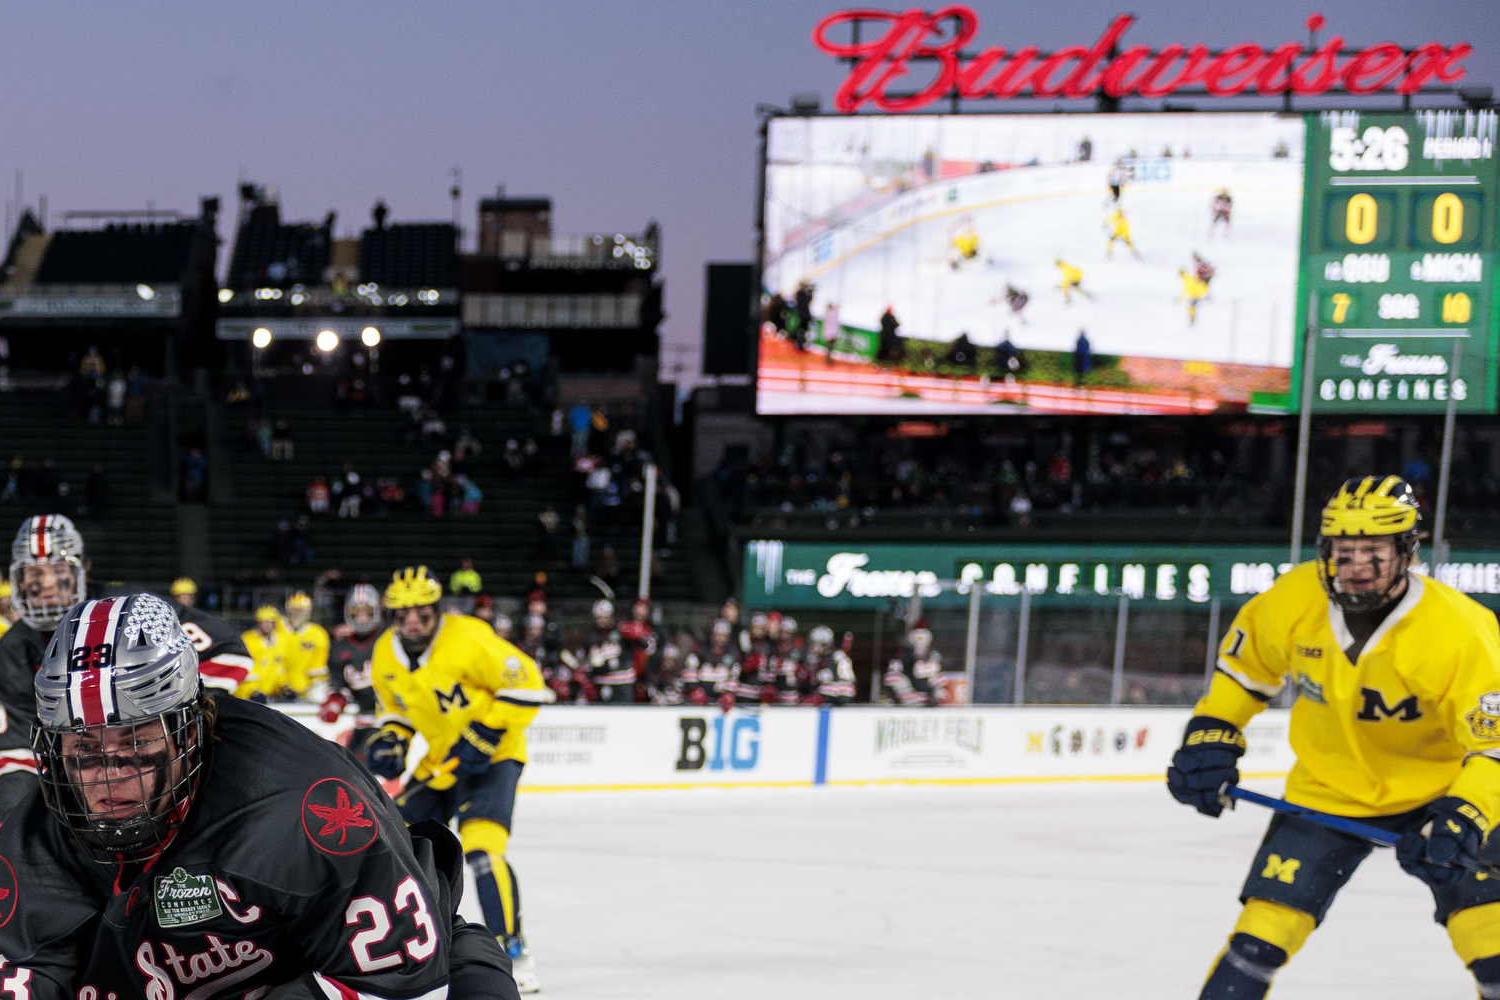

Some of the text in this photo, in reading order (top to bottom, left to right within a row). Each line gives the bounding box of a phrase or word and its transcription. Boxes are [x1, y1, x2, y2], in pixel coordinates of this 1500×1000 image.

[812, 4, 1472, 113] Budweiser
[1329, 126, 1409, 172] 5:26
[1346, 193, 1378, 245] 0
[1432, 192, 1464, 244] 0
[1331, 293, 1351, 323] 7
[1320, 378, 1467, 401] CONFINES
[957, 562, 1211, 602] CONFINES
[71, 643, 113, 673] 23
[434, 682, 471, 714] M
[1356, 686, 1423, 722] M
[1261, 854, 1301, 884] M
[157, 879, 212, 899] Frozen
[160, 897, 213, 909] CONFINES
[215, 876, 262, 924] C
[344, 875, 439, 972] 23
